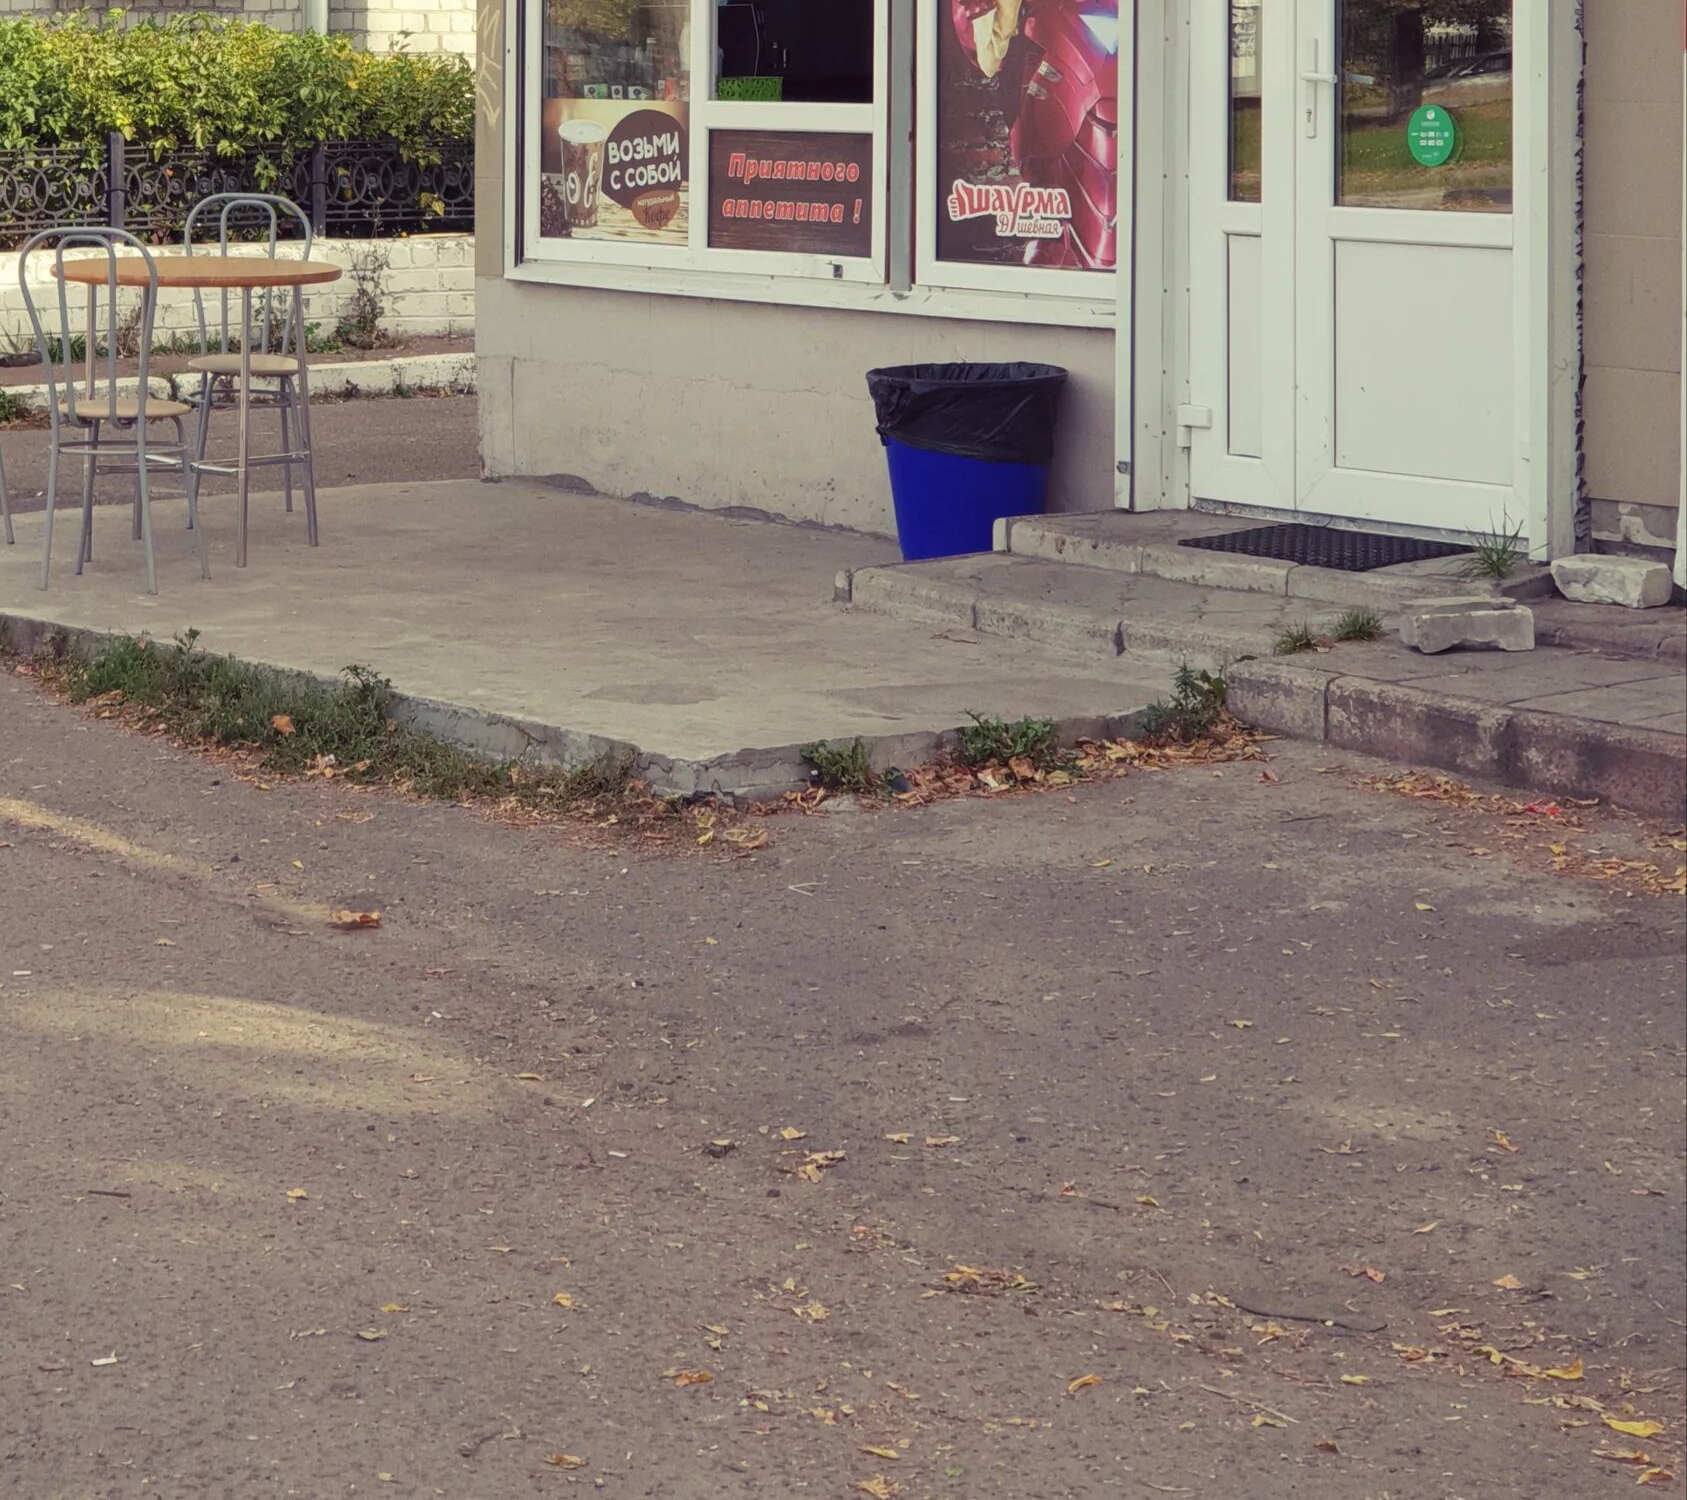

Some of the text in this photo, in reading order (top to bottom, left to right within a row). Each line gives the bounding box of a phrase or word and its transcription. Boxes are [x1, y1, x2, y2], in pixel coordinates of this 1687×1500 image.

[608, 132, 680, 164] ВОЗЬМИ
[625, 156, 682, 188] СОБОЙ
[728, 153, 860, 184] Приятного
